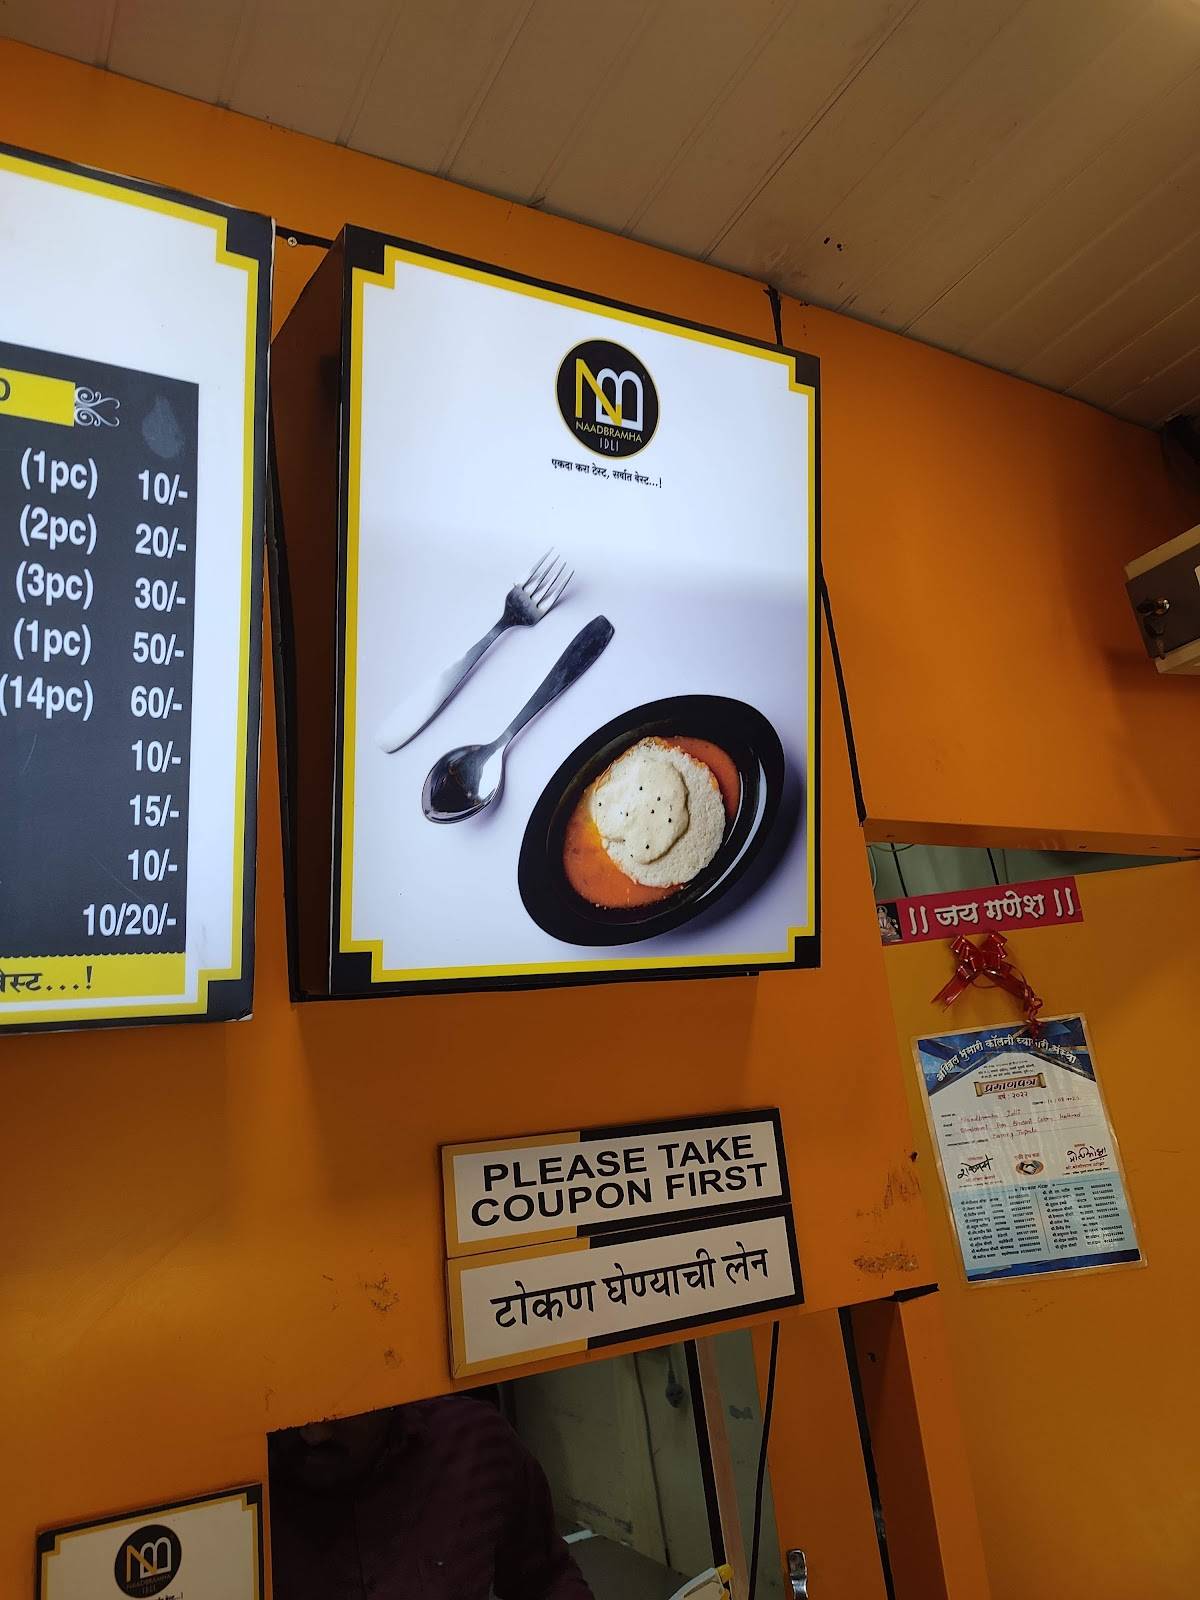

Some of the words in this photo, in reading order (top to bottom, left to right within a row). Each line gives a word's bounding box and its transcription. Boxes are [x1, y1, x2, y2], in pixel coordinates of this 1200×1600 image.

[576, 421, 643, 443] NAADBRAMHA
[600, 437, 619, 452] IDLI
[21, 448, 98, 499] (1pc)
[138, 469, 188, 506] 10/-
[551, 458, 573, 471] एकदा
[575, 462, 590, 474] करा
[19, 504, 97, 555] (2pc)
[135, 523, 187, 559] 20/-
[16, 561, 94, 610] (3pc)
[134, 577, 186, 612] 30/-
[14, 618, 91, 665] (1pc)
[132, 631, 185, 665] 50/-
[0, 673, 93, 721] (14pc)
[131, 686, 183, 719] 60/-
[131, 739, 182, 773] 10/-
[129, 794, 180, 827] 15/-
[127, 848, 178, 881] 10/-
[83, 902, 177, 937] 10/20/-
[934, 901, 980, 926] जय
[983, 890, 1045, 918] गणेश
[985, 1034, 1014, 1050] कॉलनी
[483, 1147, 648, 1192] PLEASE
[658, 1134, 754, 1169] TAKE
[471, 1177, 652, 1227] COUPON
[666, 1162, 768, 1200] FIRST
[489, 1280, 597, 1328] टोकण
[601, 1248, 717, 1305] घेण्याची
[721, 1241, 769, 1285] लेन
